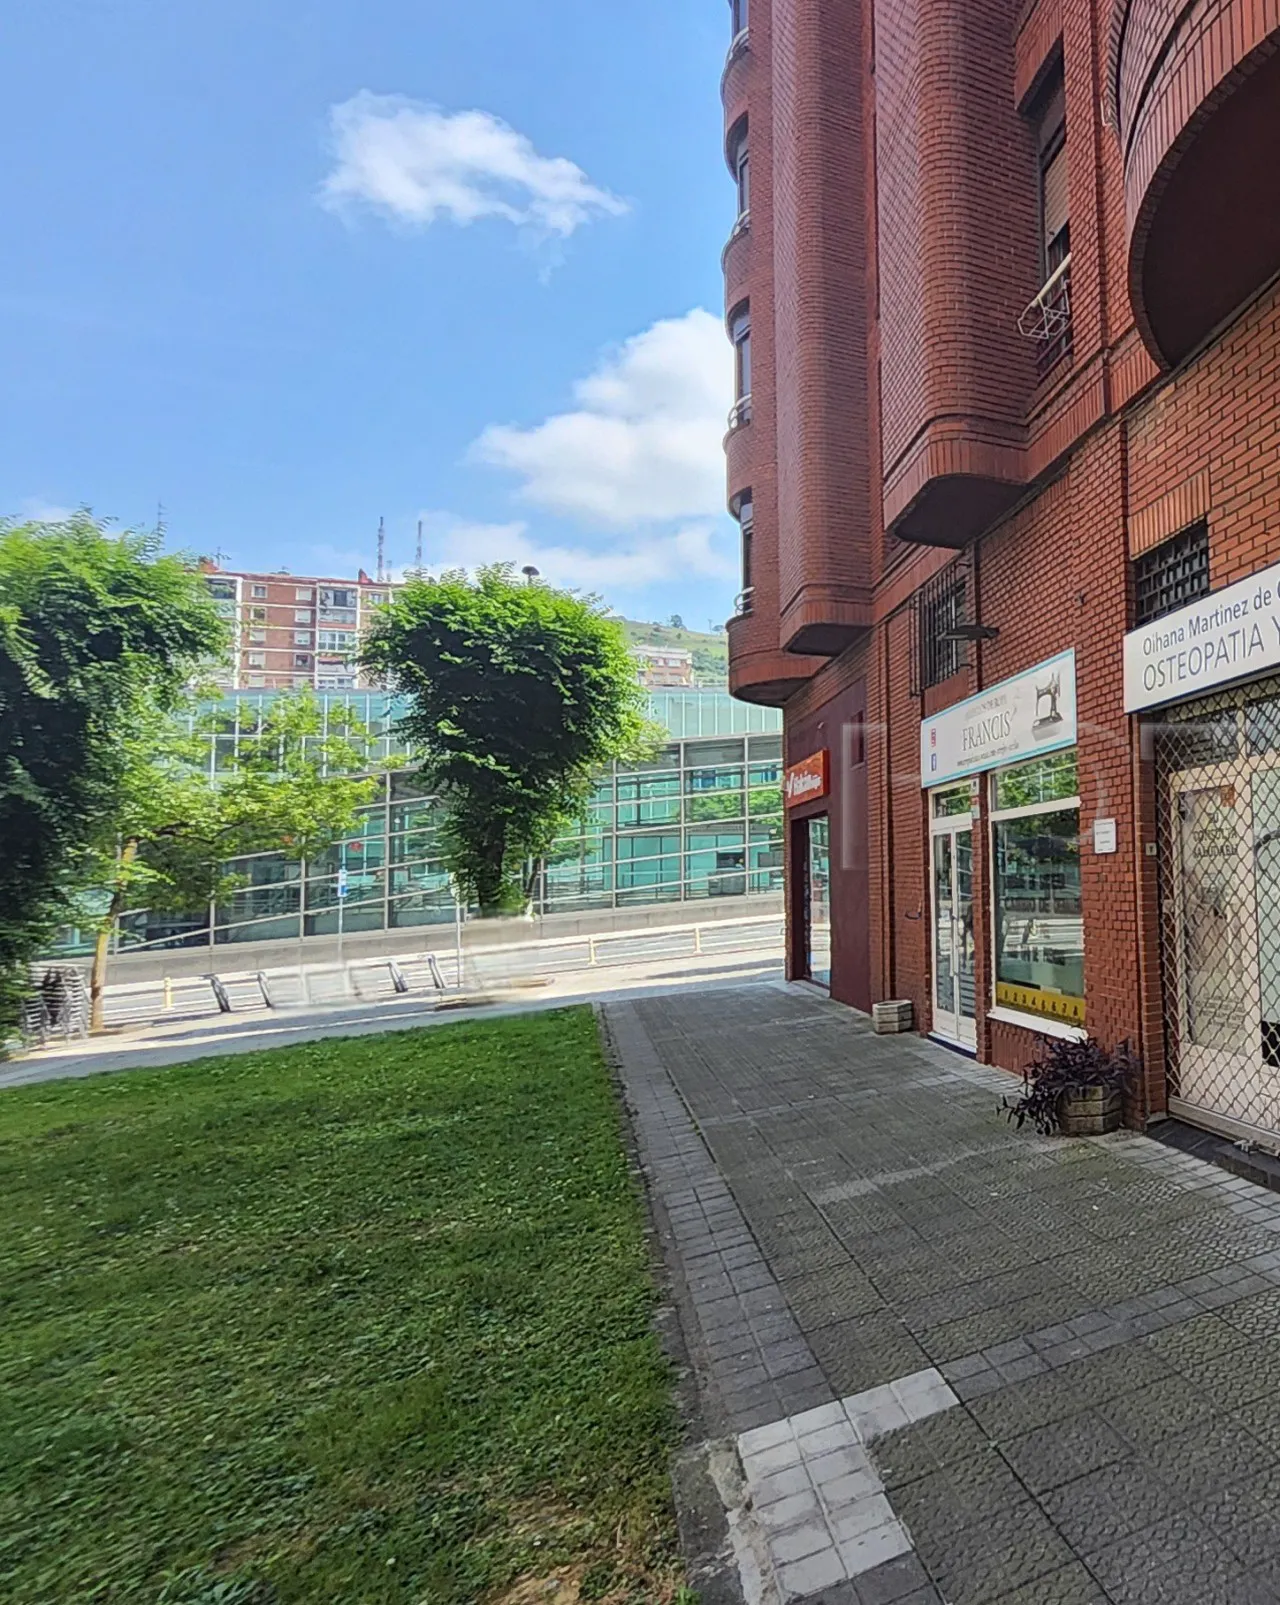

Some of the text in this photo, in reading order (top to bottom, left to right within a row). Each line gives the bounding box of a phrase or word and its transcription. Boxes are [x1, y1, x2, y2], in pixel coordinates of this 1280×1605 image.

[1142, 624, 1185, 656] Oihana
[1188, 597, 1249, 638] Martinez
[1253, 586, 1272, 611] de
[1143, 622, 1265, 692] OSTEOPATIA
[961, 710, 1012, 752] FRANCIS
